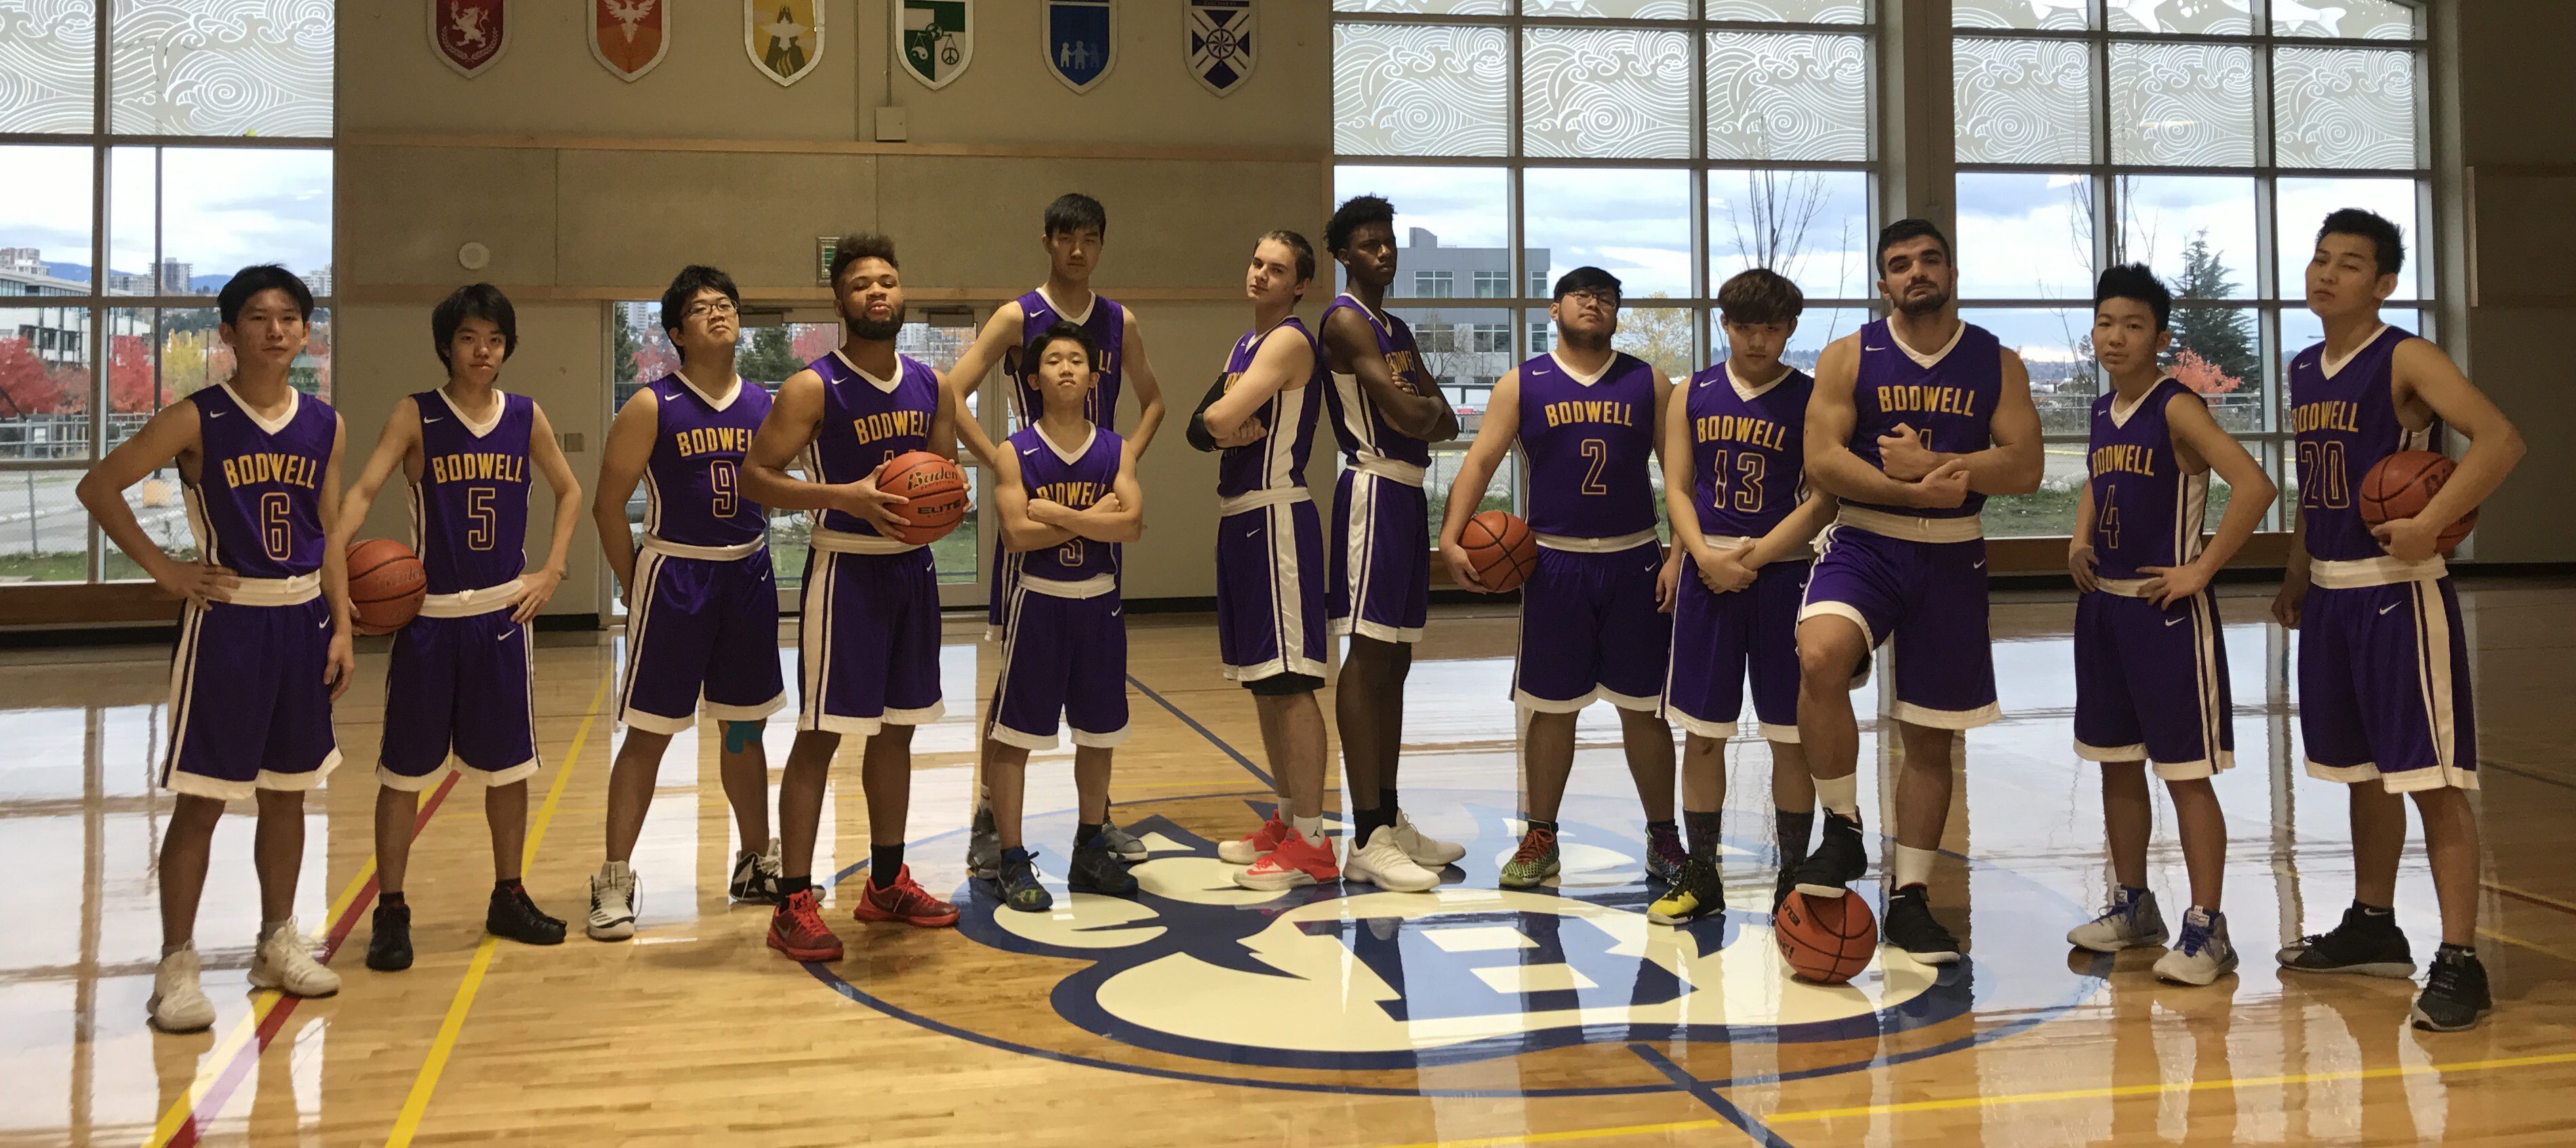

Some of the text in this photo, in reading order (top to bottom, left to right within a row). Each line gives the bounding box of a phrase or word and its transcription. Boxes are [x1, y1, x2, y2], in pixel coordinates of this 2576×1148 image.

[1544, 401, 1632, 428] BODWELL
[1876, 385, 1975, 416] BODWELL
[2292, 400, 2359, 435] BODWELL
[676, 427, 752, 457] BODWEL
[853, 410, 931, 446] BODWELL
[1697, 415, 1786, 452] BODWELL
[222, 453, 317, 490] BODWELL
[432, 453, 523, 484] BODWELL
[907, 466, 958, 491] Baden
[1581, 438, 1607, 495] 2
[2091, 444, 2154, 479] BODWELL
[2299, 441, 2350, 509] 20
[710, 460, 738, 518] 9
[1714, 449, 1765, 513] 13
[468, 487, 496, 551] 5
[917, 498, 961, 515] ELITE
[2099, 484, 2120, 549] 4
[261, 492, 291, 561] 6
